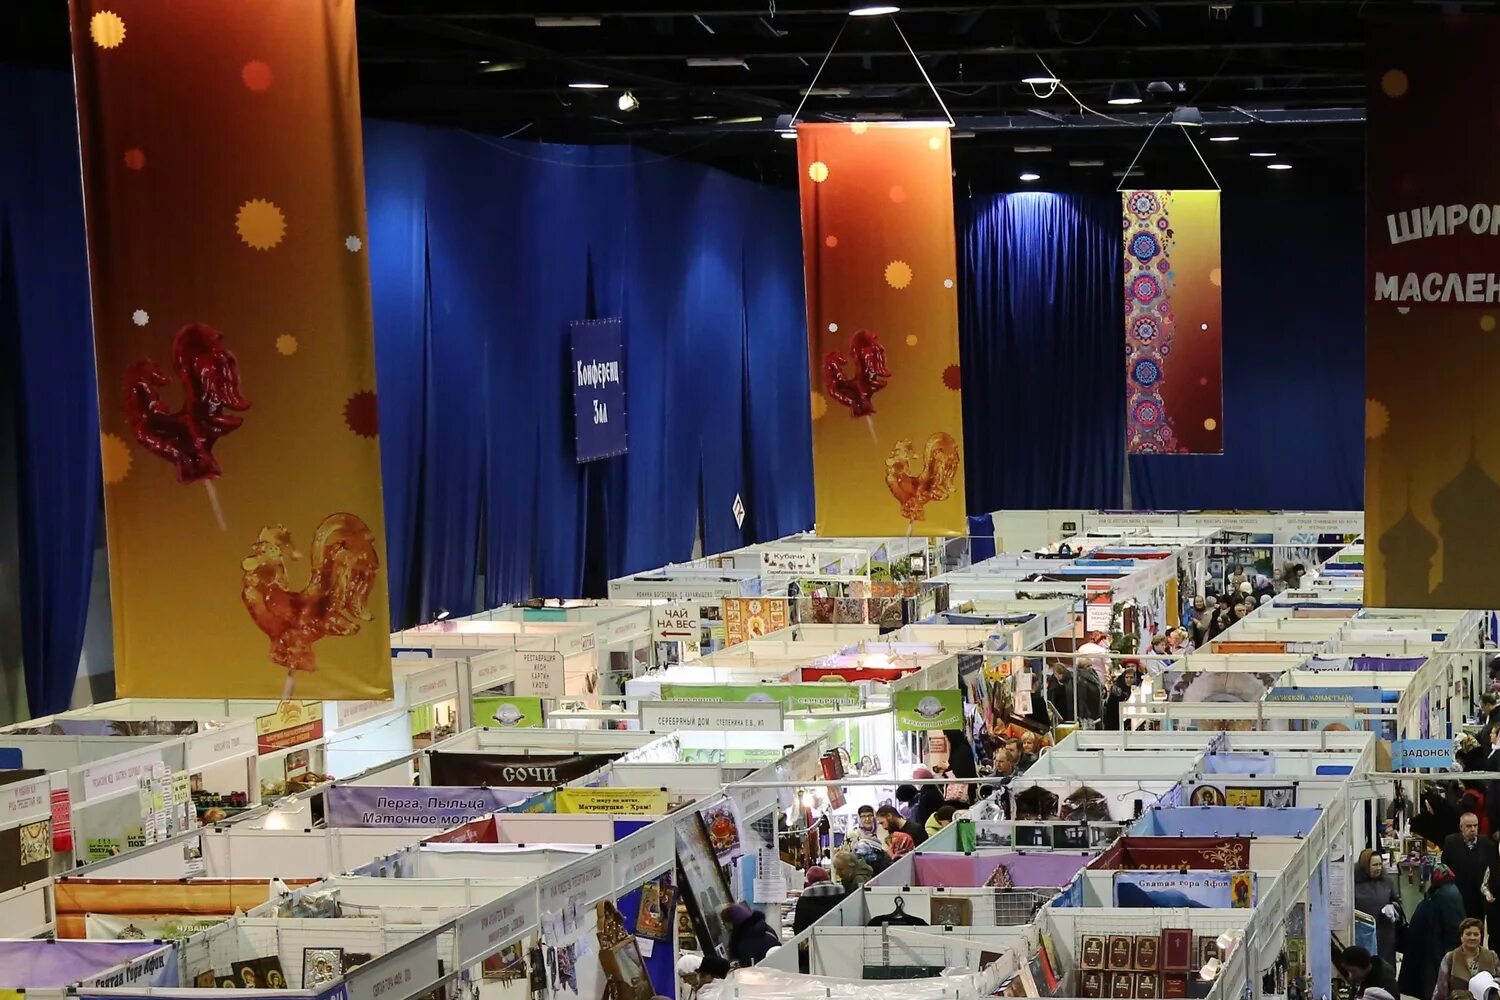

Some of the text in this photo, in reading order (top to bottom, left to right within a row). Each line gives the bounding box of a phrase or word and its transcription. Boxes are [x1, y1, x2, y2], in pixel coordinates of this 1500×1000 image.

[576, 359, 620, 388] Конференц
[592, 399, 609, 424] Зал
[664, 608, 688, 618] ЧАЙ
[657, 620, 697, 629] НА ВЕС
[657, 717, 696, 726] СЕРЕБРЯНЫЙ
[697, 717, 710, 727] ДОМ
[1402, 749, 1450, 758] ЗАДОНСК
[502, 767, 558, 782] СОЧИ
[377, 797, 485, 810] Перга, Пыльца
[362, 813, 437, 824] Маточное
[1138, 880, 1176, 888] Святая
[1179, 880, 1200, 889] гора
[143, 955, 165, 975] Афон
